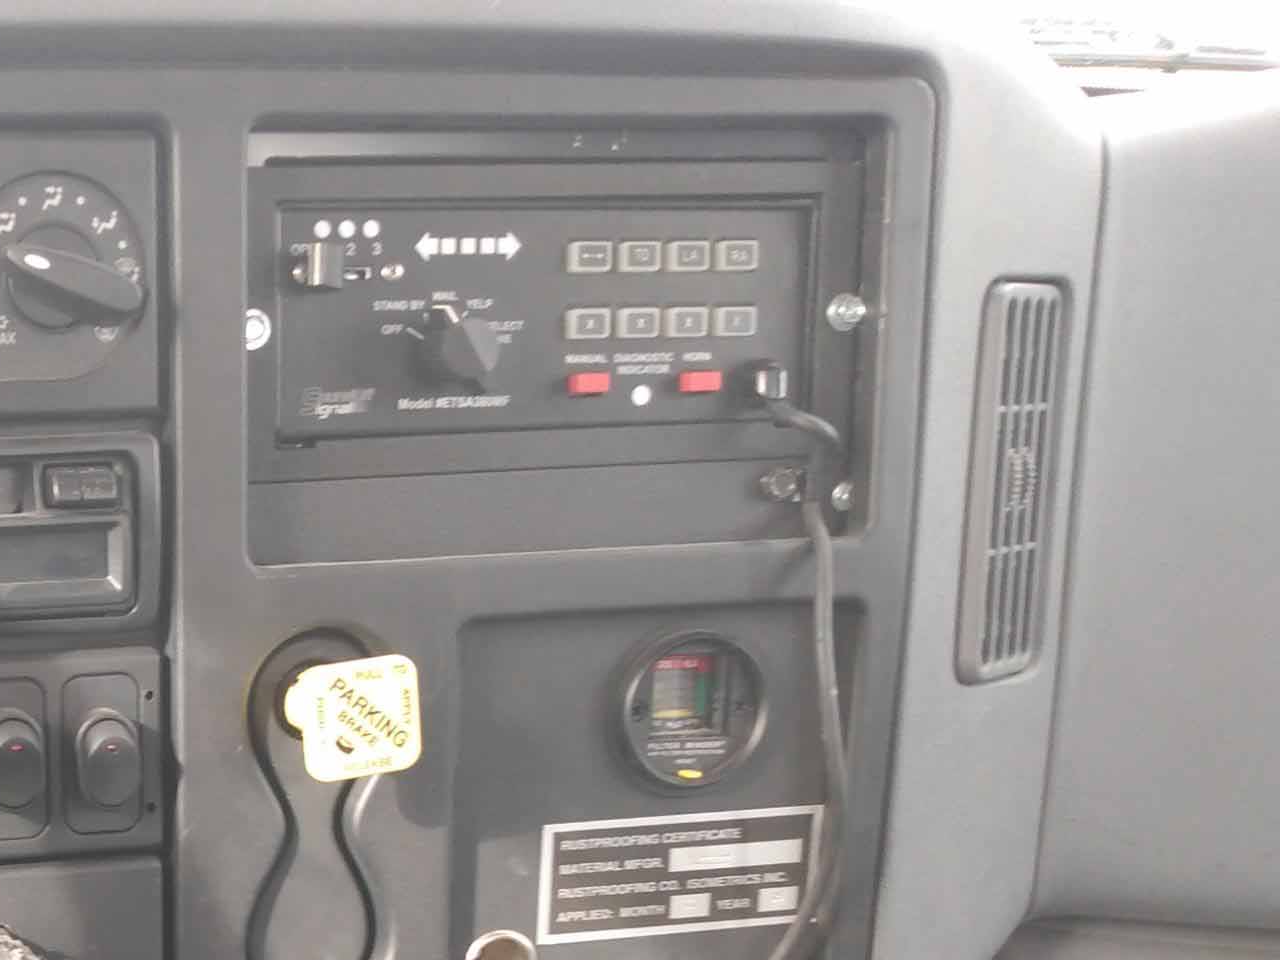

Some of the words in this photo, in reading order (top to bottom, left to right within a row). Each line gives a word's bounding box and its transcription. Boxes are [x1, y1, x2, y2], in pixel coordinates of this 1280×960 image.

[346, 243, 357, 256] 2
[372, 242, 382, 255] 3
[372, 300, 408, 311] STAND
[380, 325, 404, 335] OFF
[328, 676, 410, 749] PARKING
[559, 833, 660, 851] RUSTPROOFING
[662, 828, 744, 844] CERTIFICATE
[556, 881, 658, 899] RUSTPROOFING
